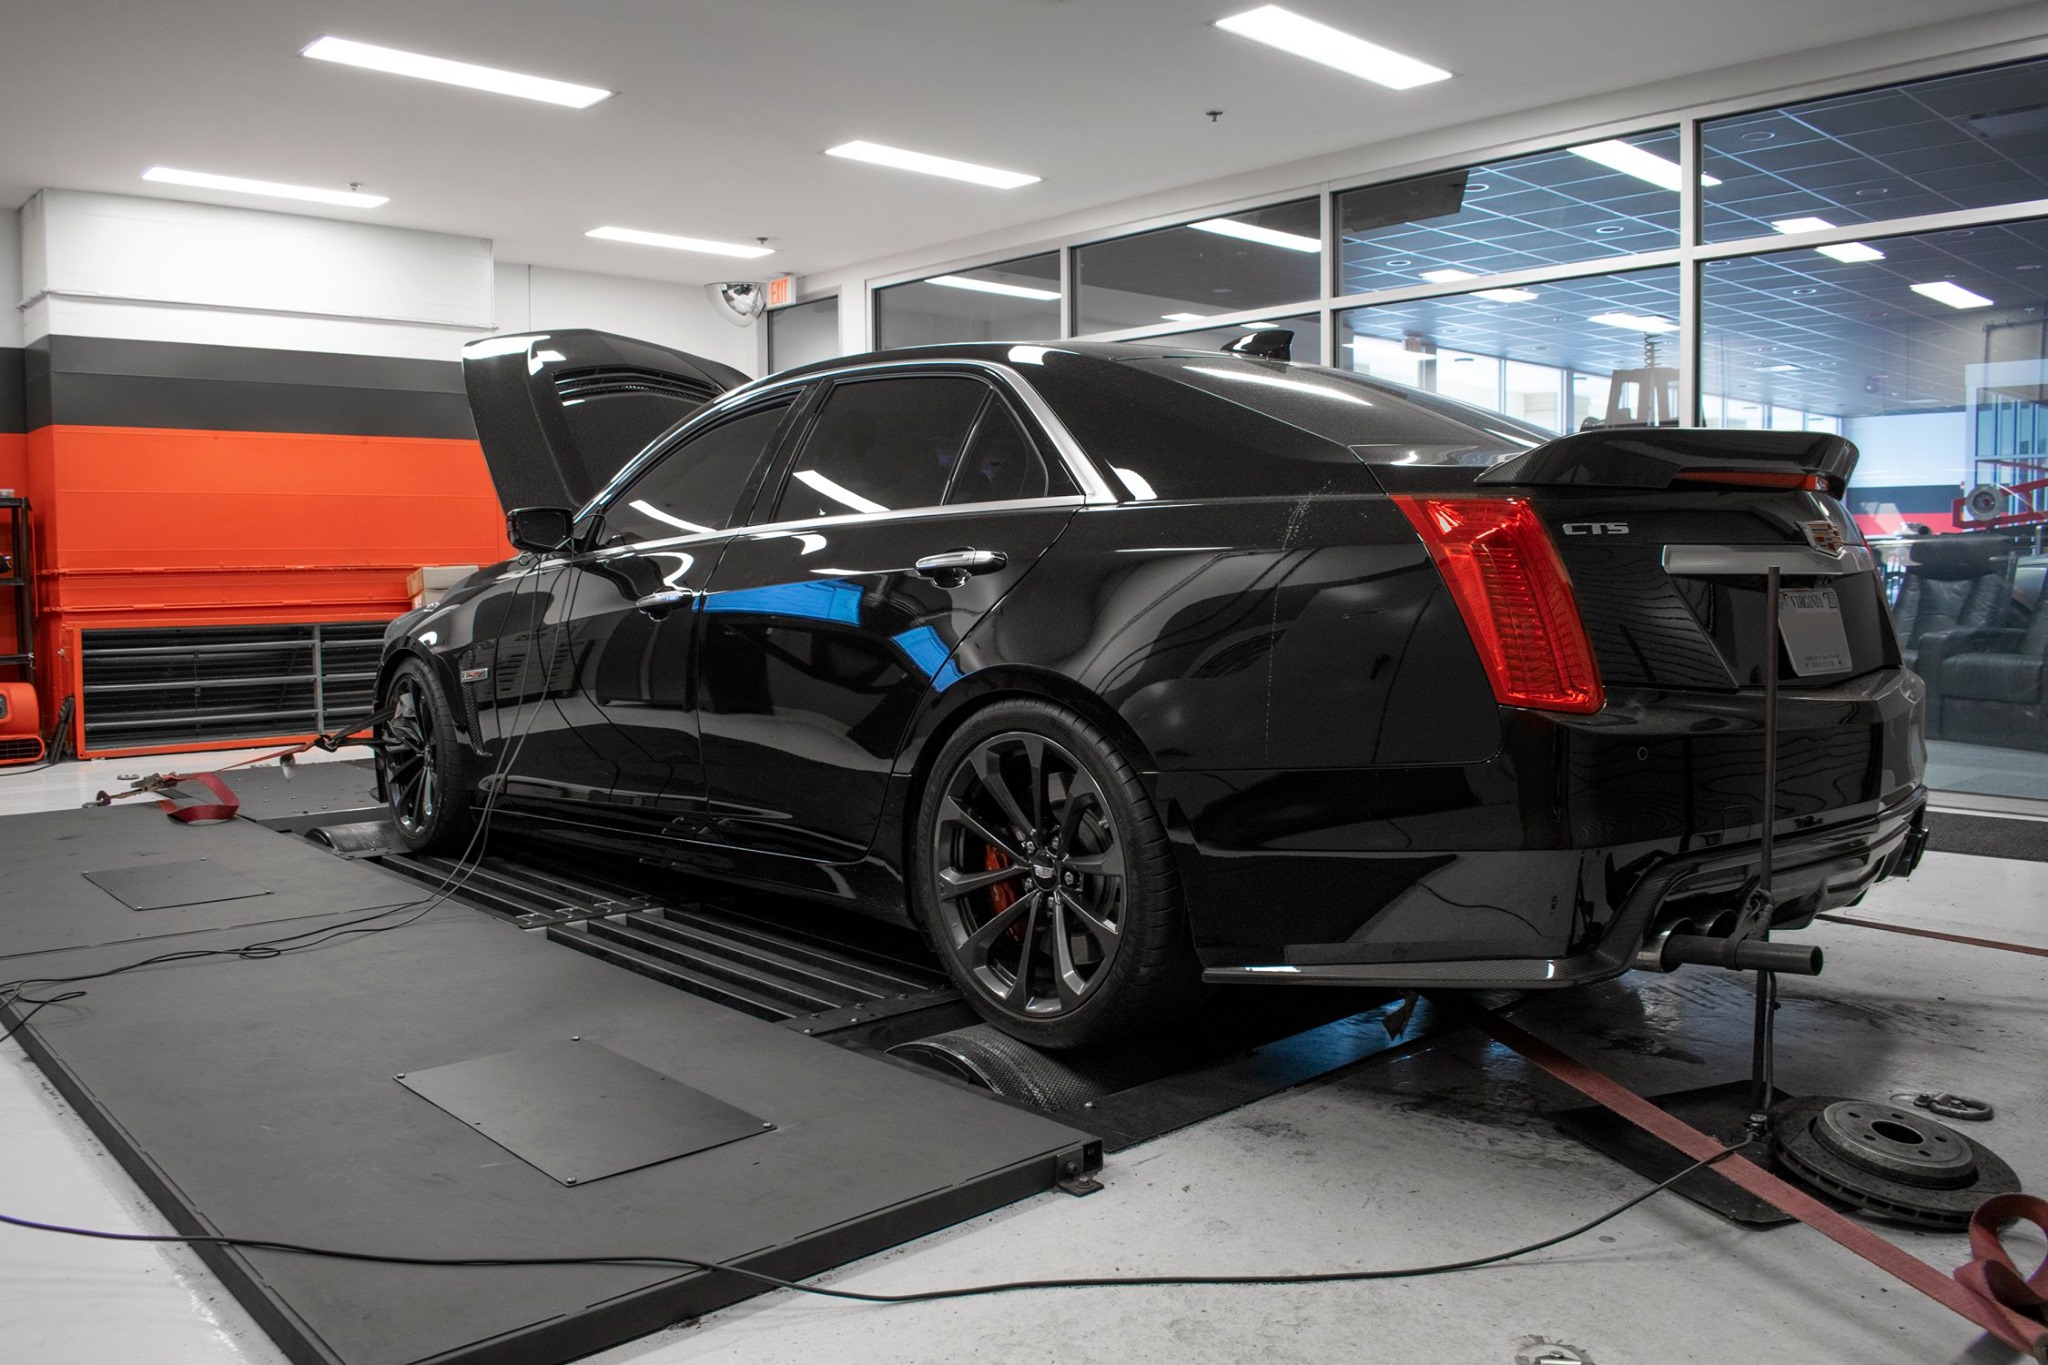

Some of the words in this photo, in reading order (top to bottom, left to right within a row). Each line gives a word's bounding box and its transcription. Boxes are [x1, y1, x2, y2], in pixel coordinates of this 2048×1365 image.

[770, 277, 788, 304] EXIT
[1562, 522, 1630, 535] CTS
[1790, 595, 1824, 608] VIRGINIA
